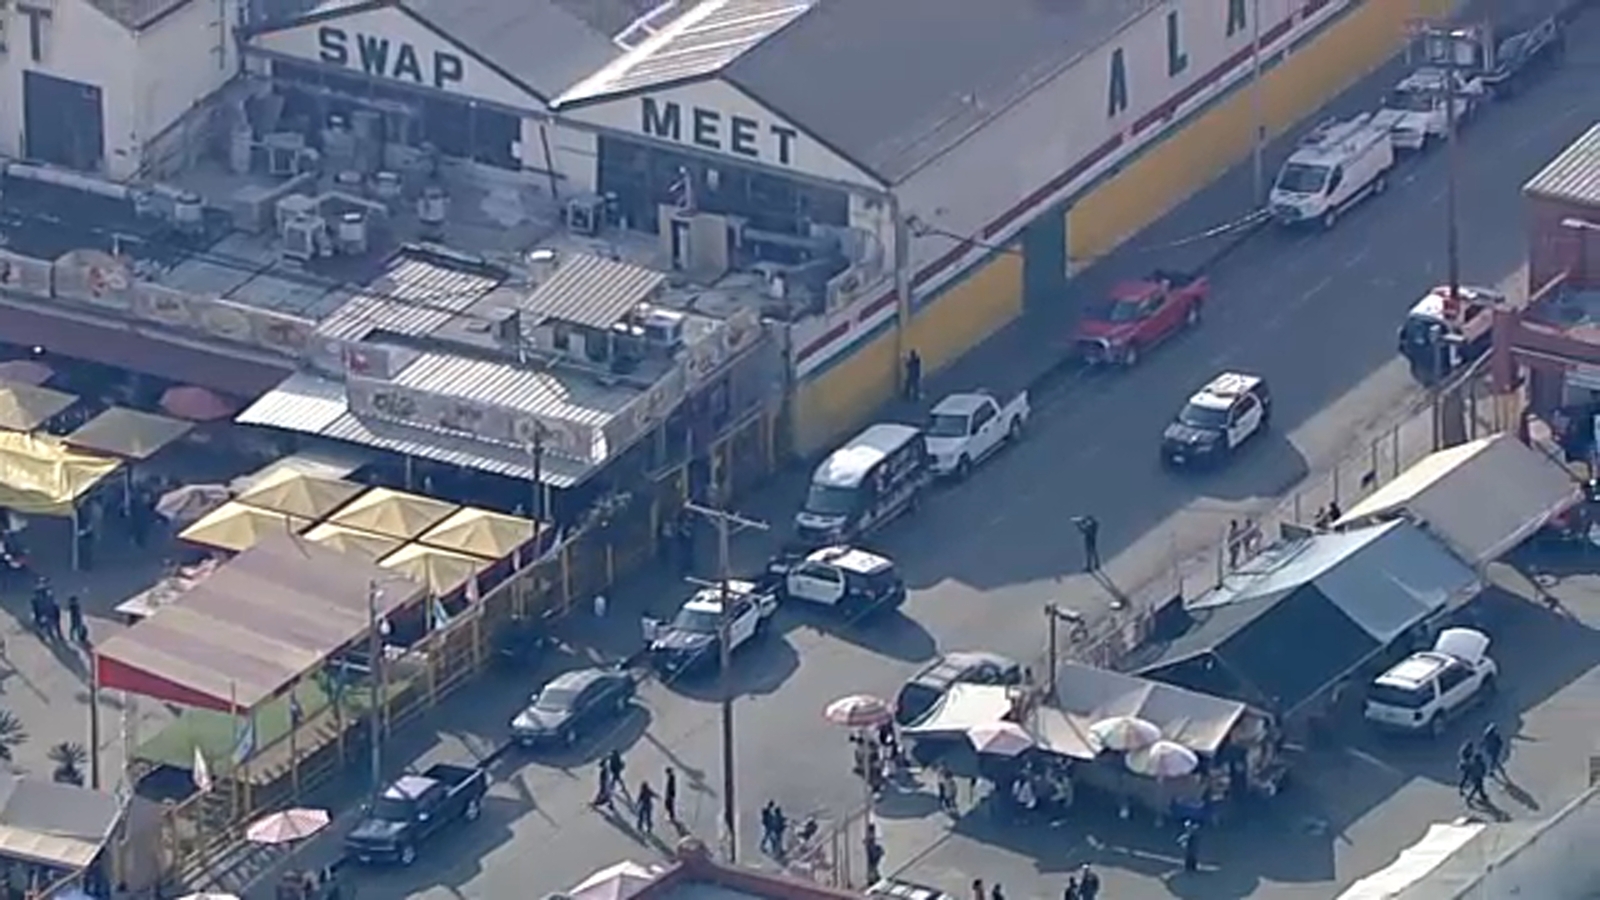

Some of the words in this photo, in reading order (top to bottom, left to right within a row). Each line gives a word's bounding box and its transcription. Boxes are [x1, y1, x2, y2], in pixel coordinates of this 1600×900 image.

[0, 0, 53, 62] T
[318, 26, 463, 88] SWAP
[641, 97, 797, 164] MEET
